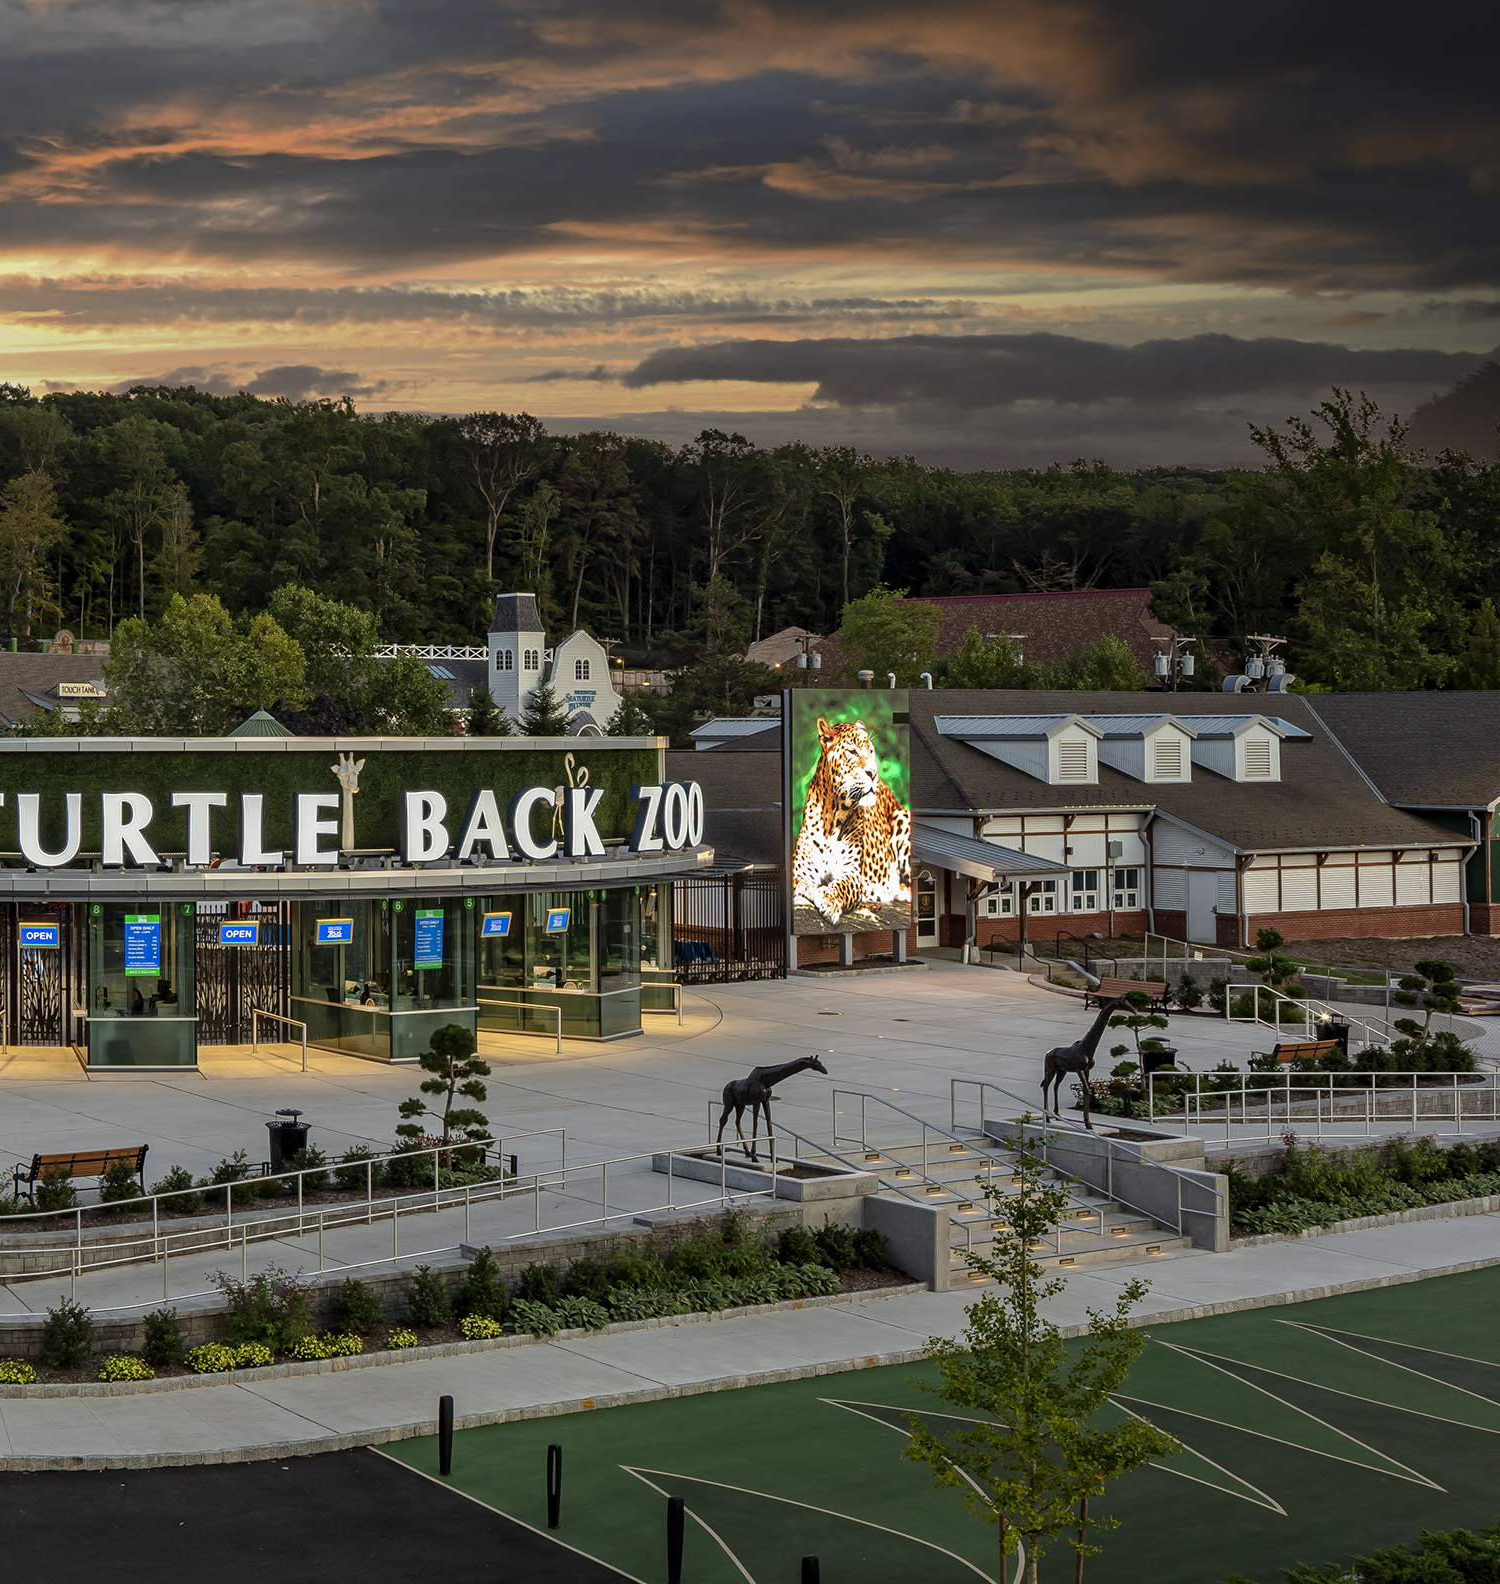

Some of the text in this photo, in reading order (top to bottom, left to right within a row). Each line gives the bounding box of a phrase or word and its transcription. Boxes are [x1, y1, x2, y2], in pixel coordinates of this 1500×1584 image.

[401, 787, 606, 863] BACK
[630, 781, 704, 852] ZOO
[588, 890, 594, 898] 4
[395, 901, 401, 910] 6
[467, 898, 472, 907] 5
[93, 905, 100, 914] 8
[184, 905, 190, 913] 7
[26, 932, 52, 940] OPEN
[225, 930, 252, 938] OPEN
